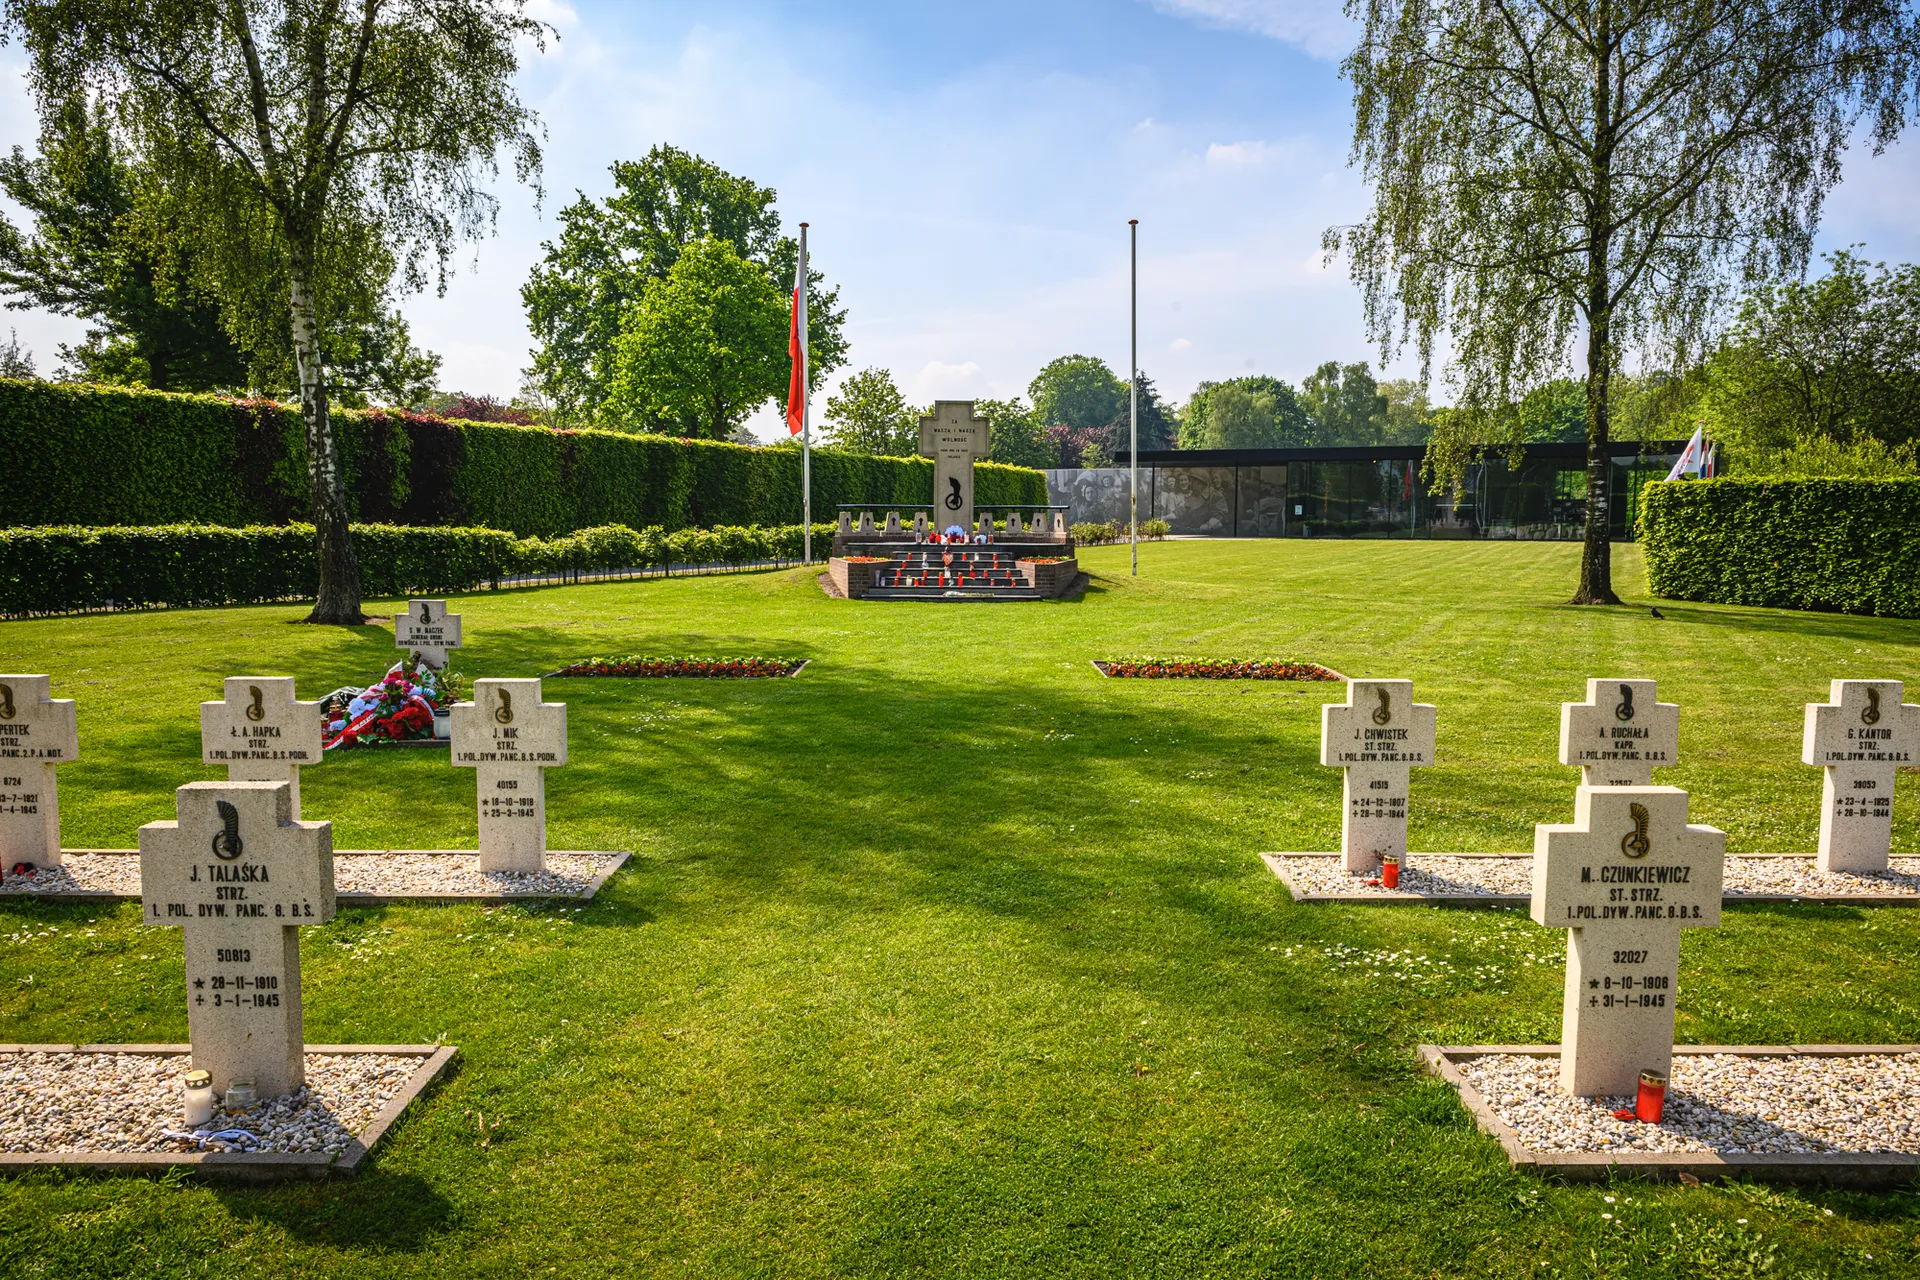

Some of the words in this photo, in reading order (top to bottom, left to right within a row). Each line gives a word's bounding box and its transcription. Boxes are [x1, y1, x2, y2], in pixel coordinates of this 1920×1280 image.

[253, 726, 281, 737] HAPKA
[492, 728, 500, 739] J.
[504, 728, 519, 739] MIK
[1354, 728, 1362, 740] J.
[1364, 728, 1408, 740] CHWISTEK
[1599, 728, 1608, 738] A.
[1611, 727, 1649, 738] RUCHAŁA
[1848, 728, 1856, 739] G.
[1859, 729, 1892, 740] KANTOR
[1, 738, 21, 746] STRZ.
[249, 739, 270, 748] STRZ.
[497, 741, 518, 750] STRZ.
[1615, 741, 1636, 749] KAPR.
[1859, 741, 1880, 750] STRZ.
[496, 781, 518, 789] 40155
[1369, 781, 1389, 789] 41515
[190, 865, 201, 882] J.
[208, 862, 269, 882] TALAŚKA
[1581, 867, 1596, 883] M.
[1601, 866, 1691, 883] CZUNKIEWICZ
[216, 886, 248, 900] STRZ.
[168, 904, 193, 917] POL.
[200, 904, 228, 917] DYW.
[236, 904, 268, 917] PANC.
[217, 949, 251, 962] 50813
[1613, 950, 1648, 964] 32027
[212, 976, 278, 989] 28-11-1910
[1603, 994, 1665, 1007] 31-1-1945
